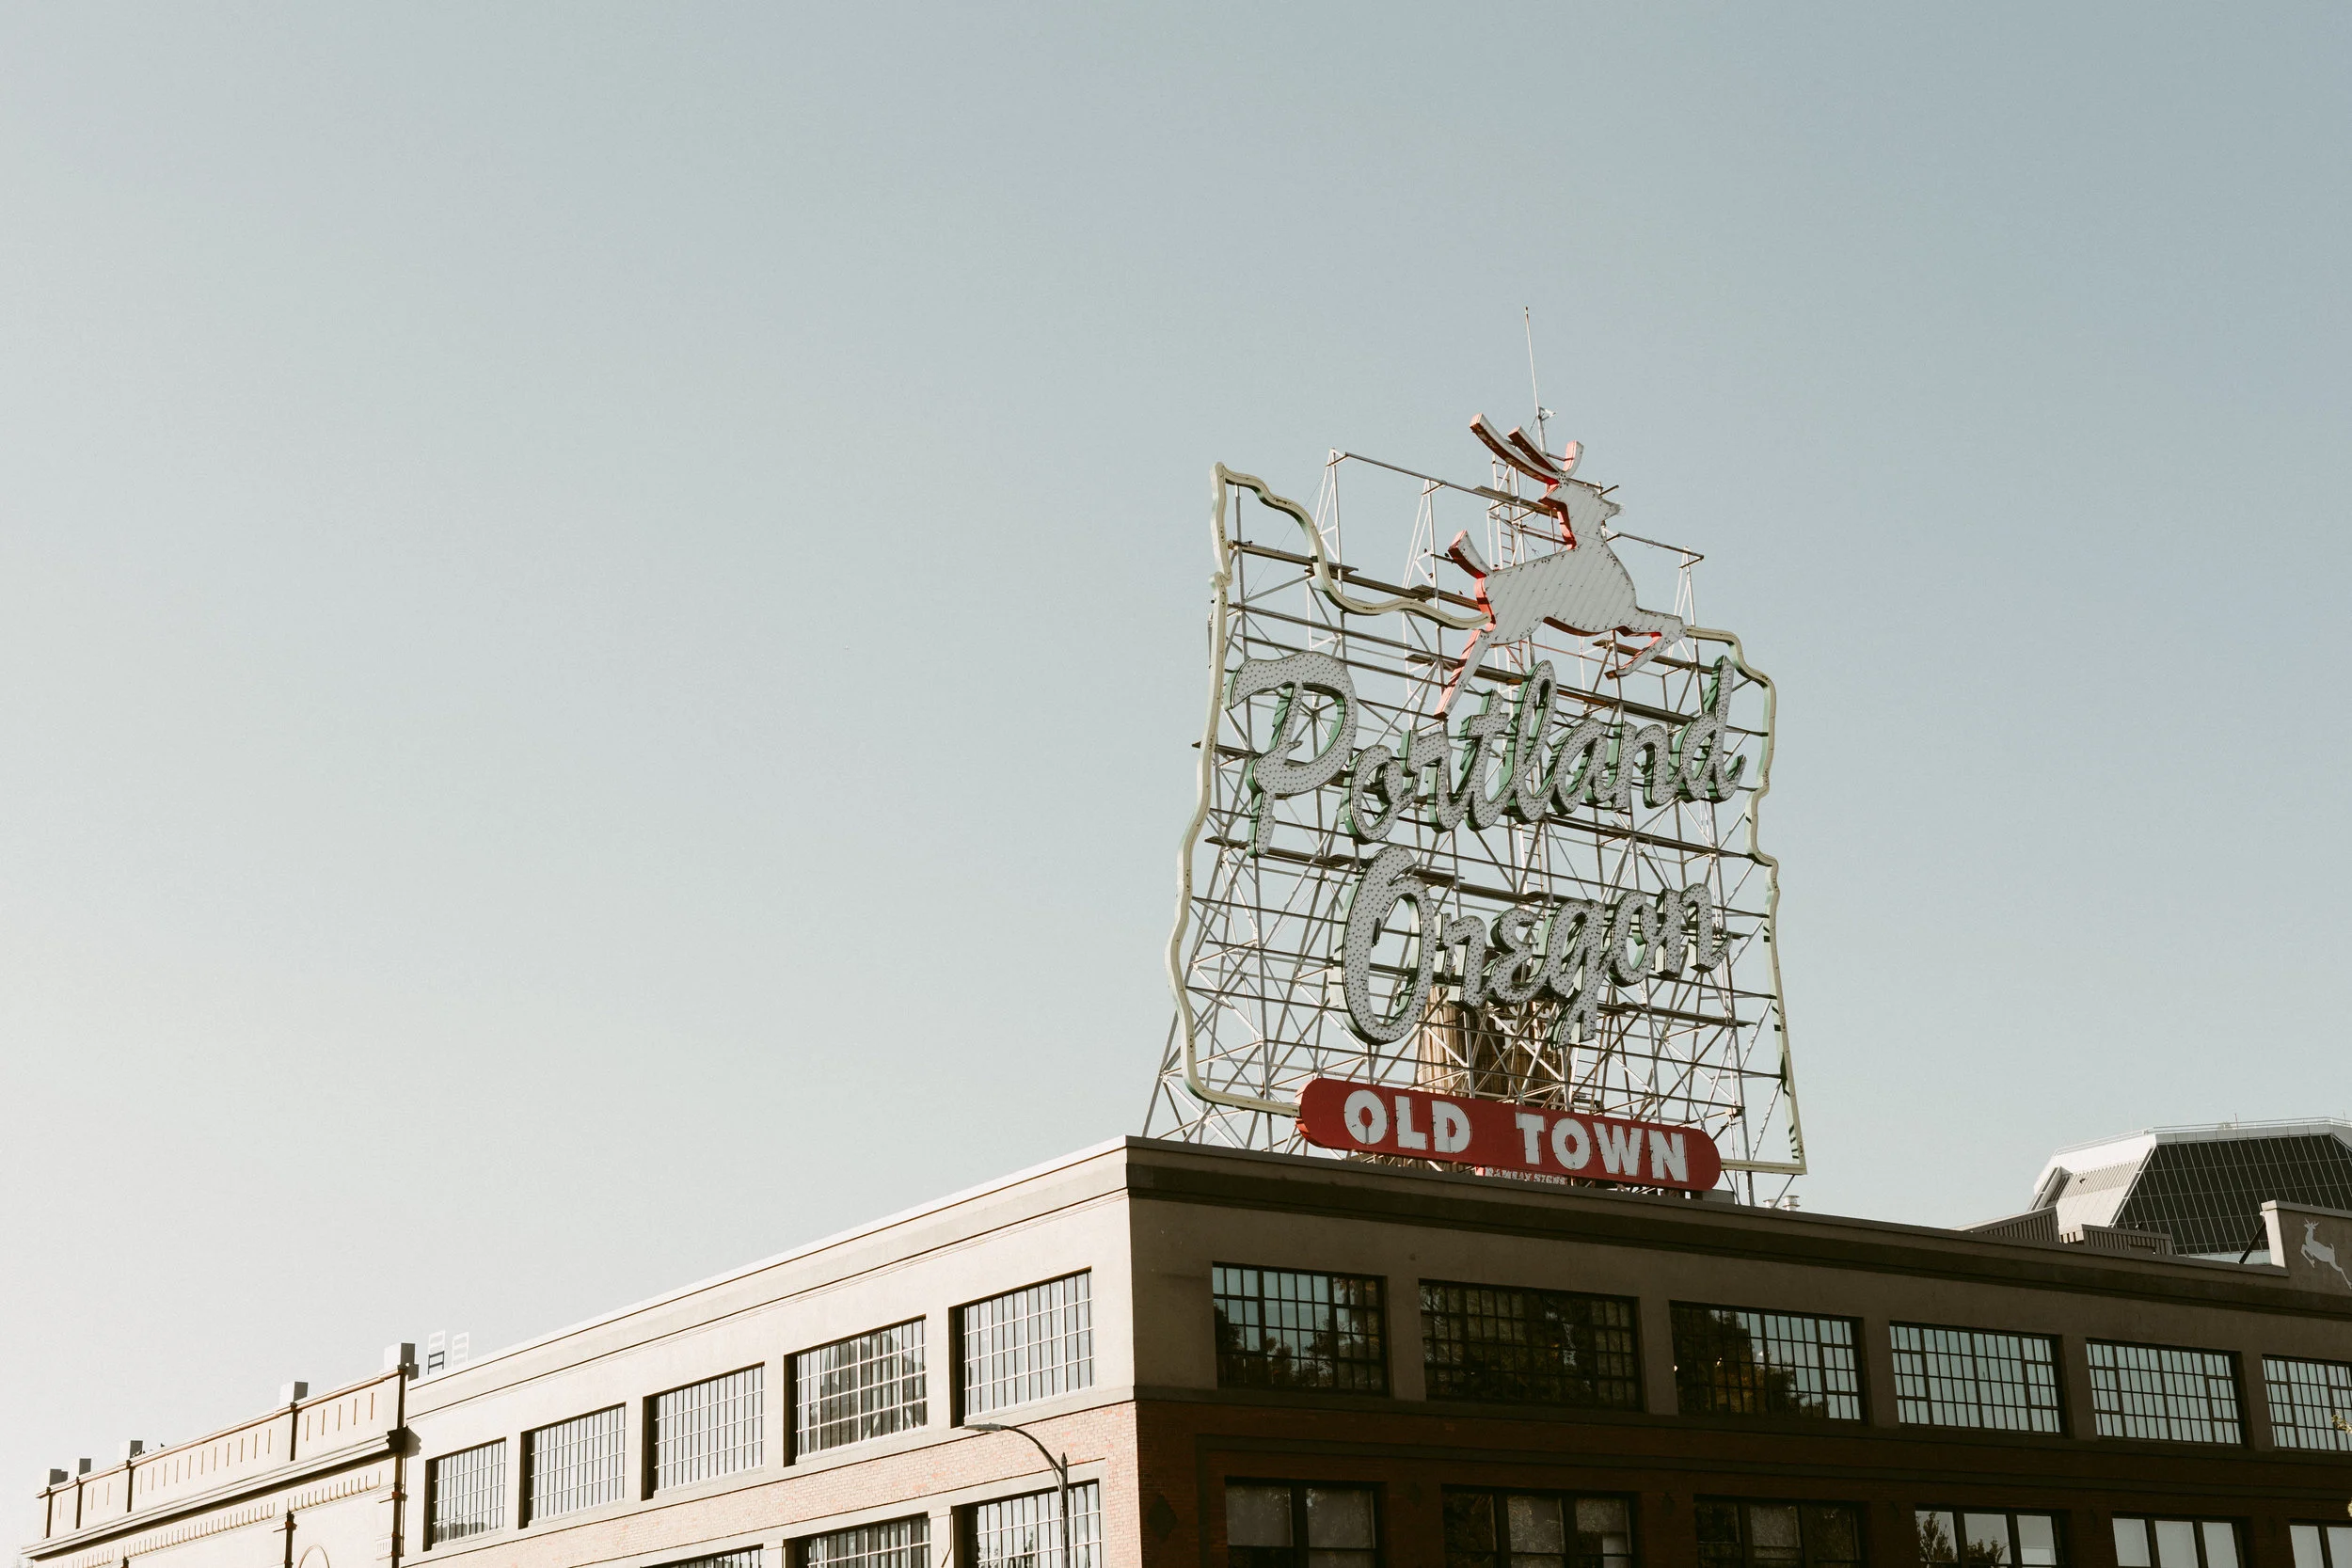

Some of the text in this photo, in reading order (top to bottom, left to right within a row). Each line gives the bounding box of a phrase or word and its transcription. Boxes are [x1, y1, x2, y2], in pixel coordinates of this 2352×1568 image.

[1227, 651, 1747, 856] Portland
[1338, 846, 1733, 1047] Oregon
[1343, 1088, 1690, 1183] OLD TOWN
[1485, 1166, 1565, 1184] RAMSAY SIGNS
